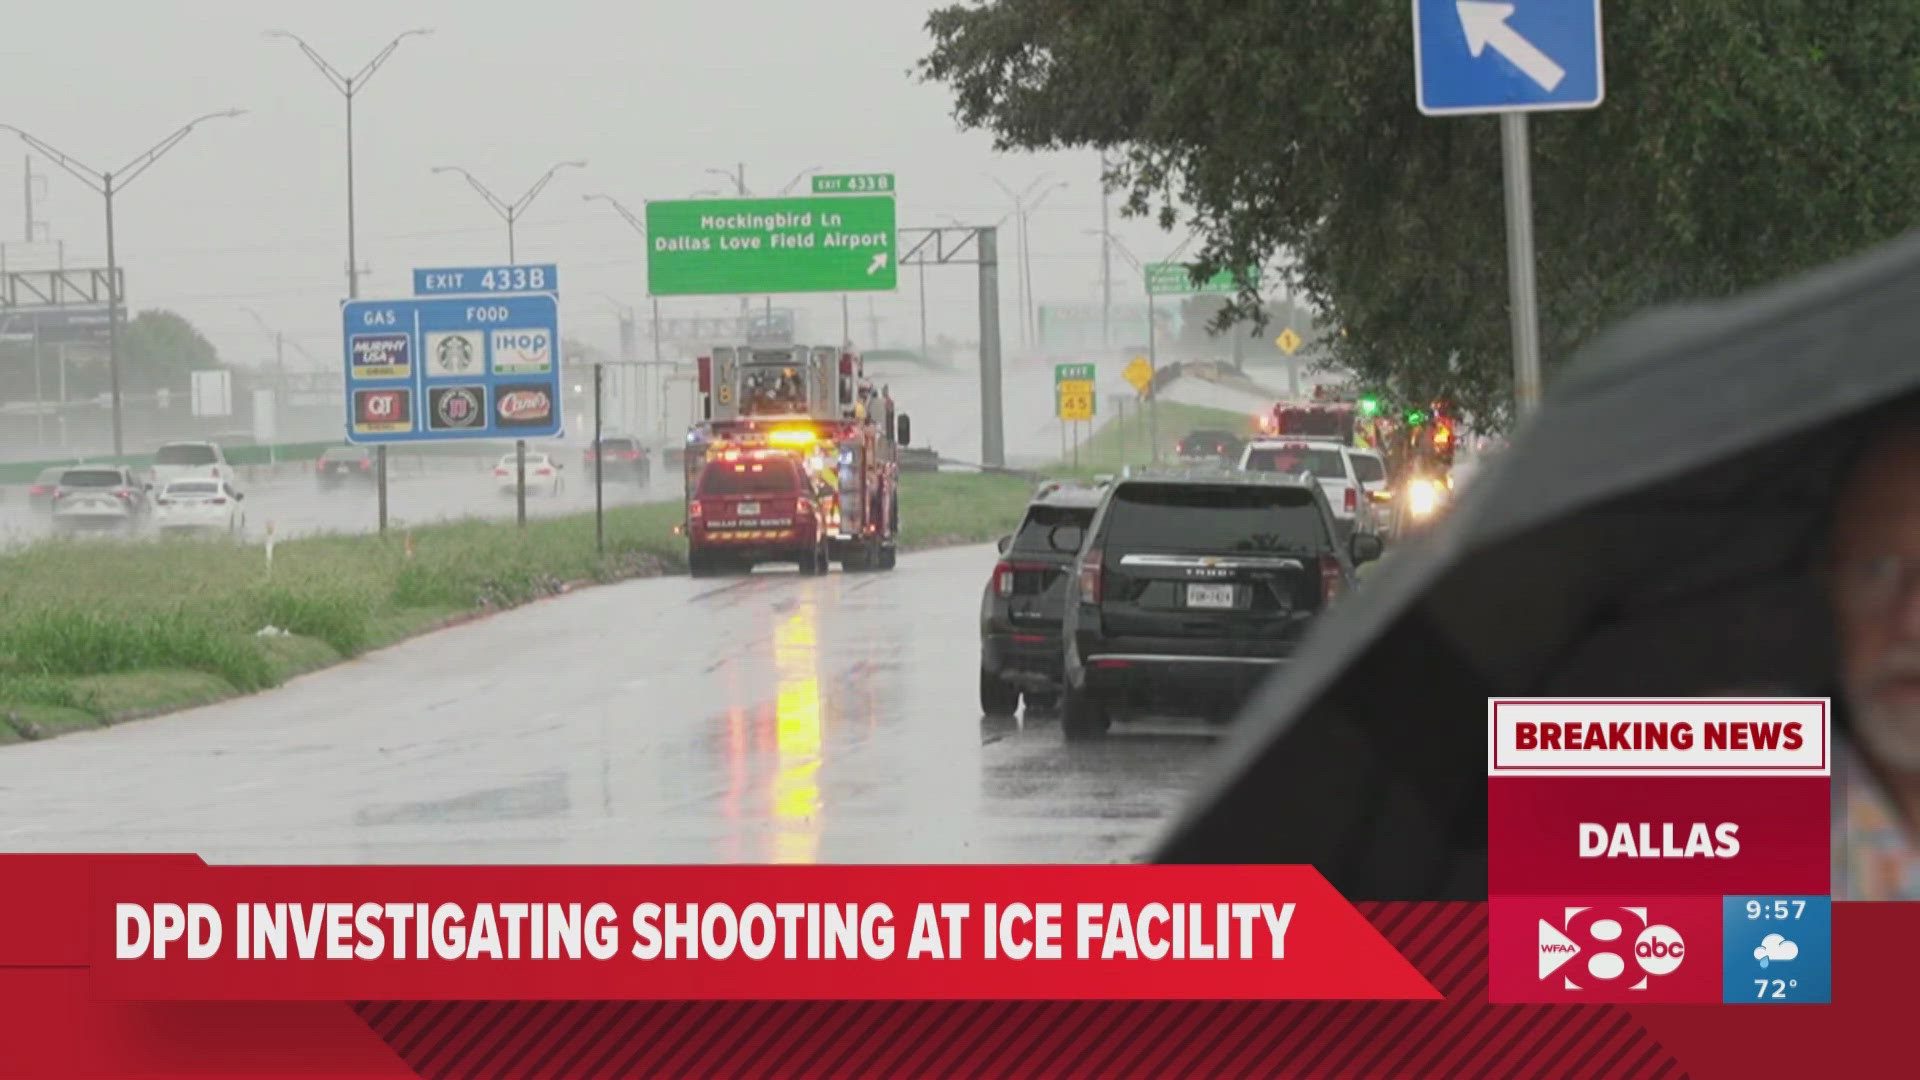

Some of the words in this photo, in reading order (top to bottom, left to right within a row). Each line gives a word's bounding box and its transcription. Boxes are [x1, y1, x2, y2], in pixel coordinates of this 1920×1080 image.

[818, 178, 841, 190] EXIT
[701, 212, 812, 231] Mockingbird
[821, 213, 842, 227] Ln
[655, 235, 711, 251] Dallas
[720, 234, 761, 249] Love
[770, 233, 814, 248] Field
[824, 231, 887, 249] Airport
[425, 273, 464, 289] EXIT
[481, 268, 546, 291] 433B
[363, 310, 396, 325] GAS
[466, 306, 509, 322] FOOD
[354, 340, 406, 352] MURPHY
[363, 352, 388, 363] USA
[368, 396, 393, 416] QT
[1064, 397, 1088, 410] 45
